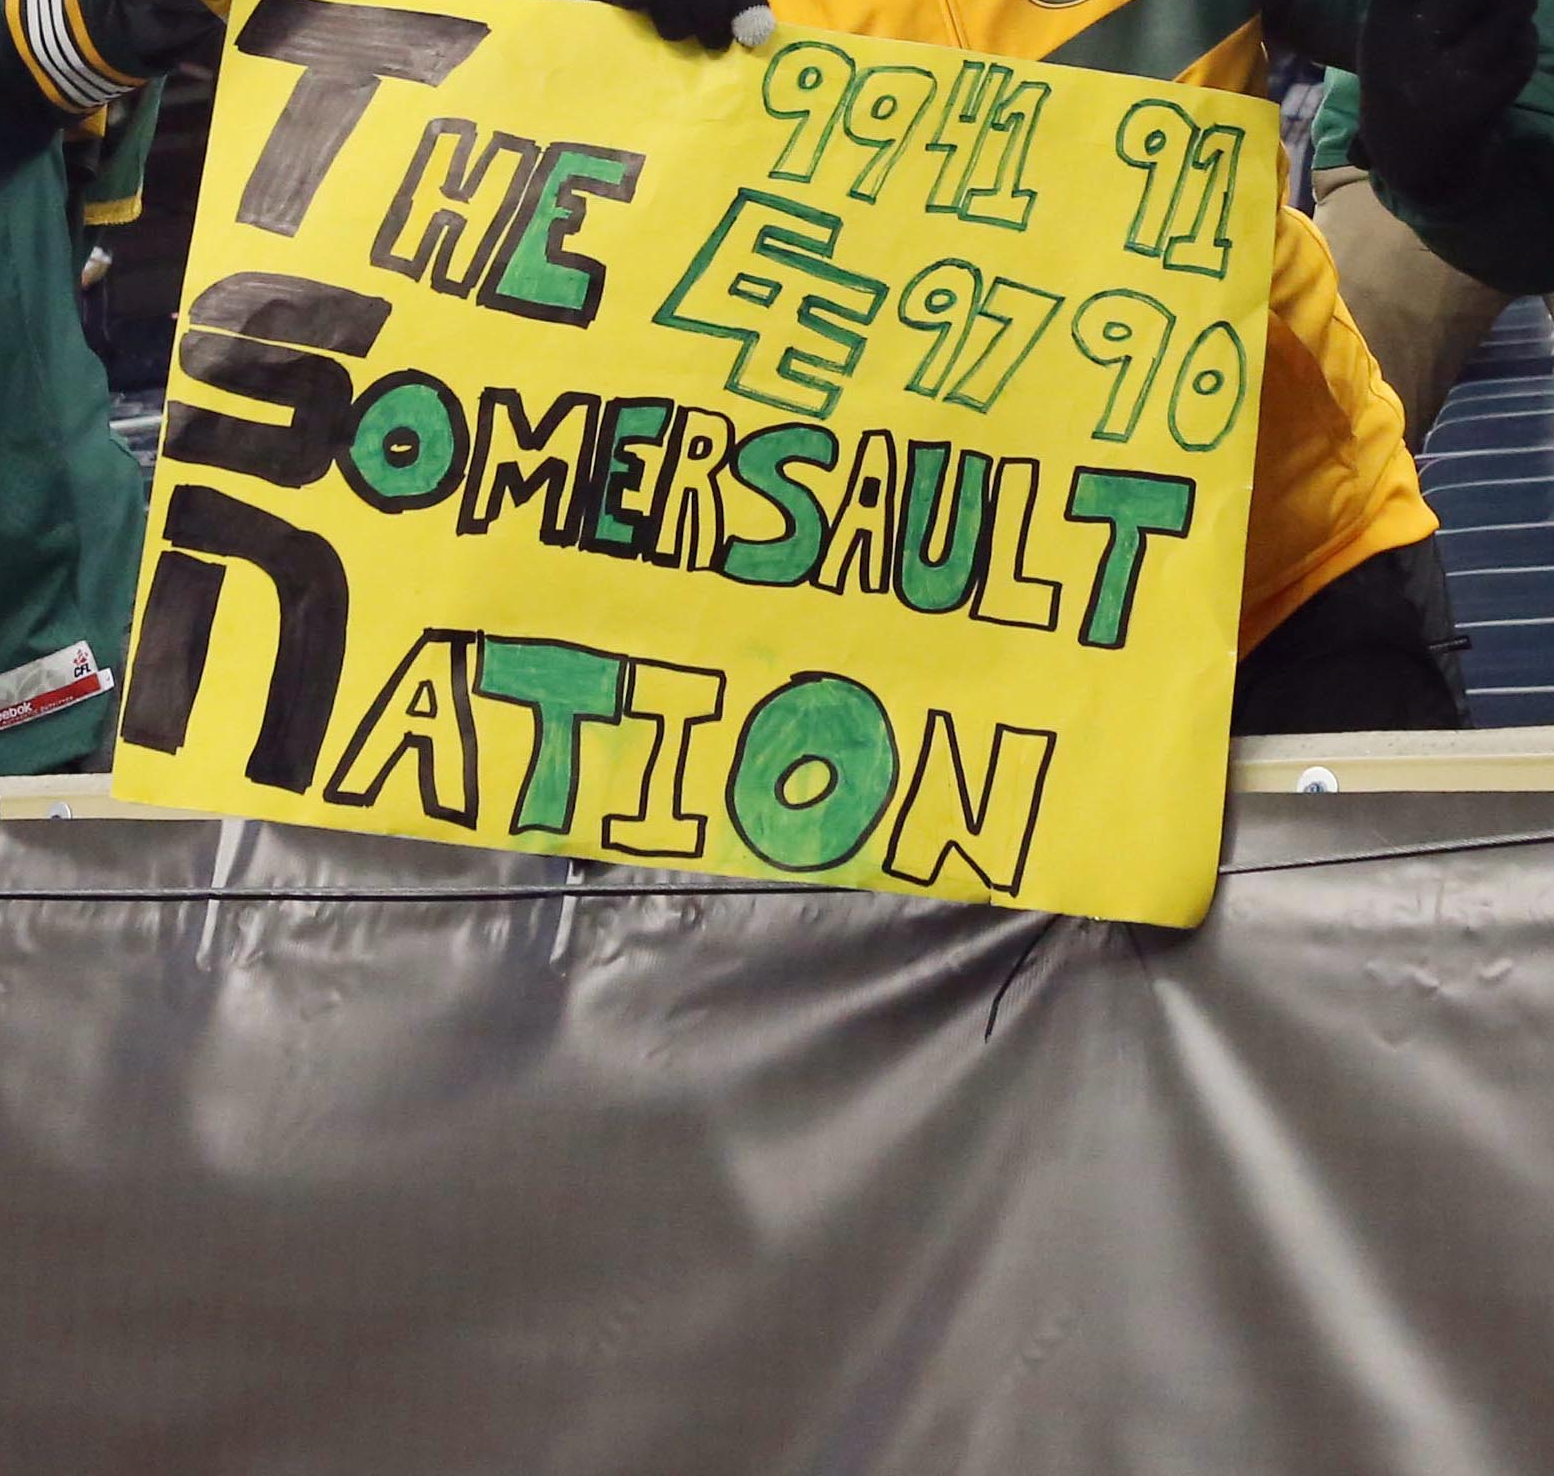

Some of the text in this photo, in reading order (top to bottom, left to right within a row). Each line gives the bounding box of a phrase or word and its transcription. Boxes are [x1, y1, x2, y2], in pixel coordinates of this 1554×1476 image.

[1115, 98, 1246, 280] 91
[161, 271, 1195, 650] SOMERSAULT
[73, 662, 93, 678] CFL
[120, 483, 1058, 896] NATION
